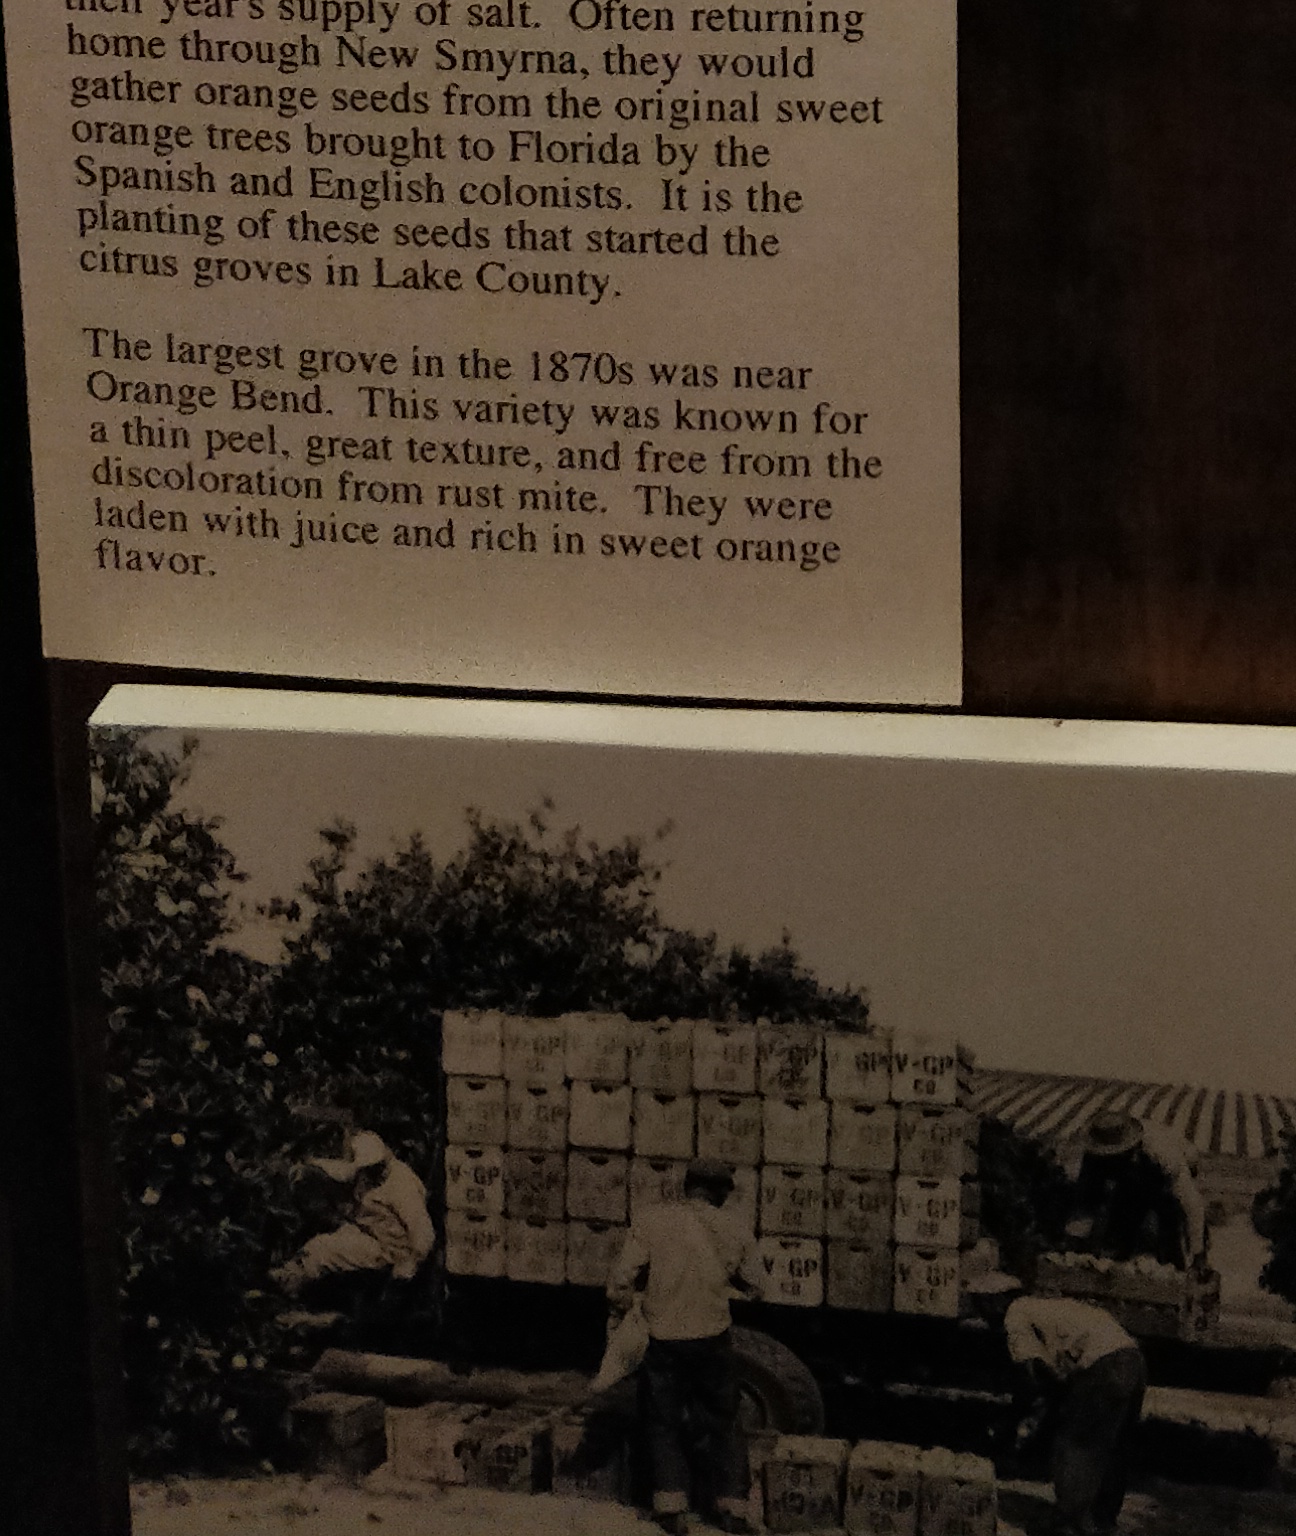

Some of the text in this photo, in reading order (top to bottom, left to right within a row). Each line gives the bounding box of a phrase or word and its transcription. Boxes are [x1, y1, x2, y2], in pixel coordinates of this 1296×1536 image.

[80, 328, 814, 391] The largest grove in the 1870s was near
[85, 371, 870, 436] Orange Bend. This variety was known for
[88, 414, 883, 480] a thin peel, great texture, and free from the
[90, 455, 834, 527] discoloration from rust mite. They were
[93, 496, 842, 574] laden with juice and rich in sweet orange
[93, 538, 218, 578] flavor.
